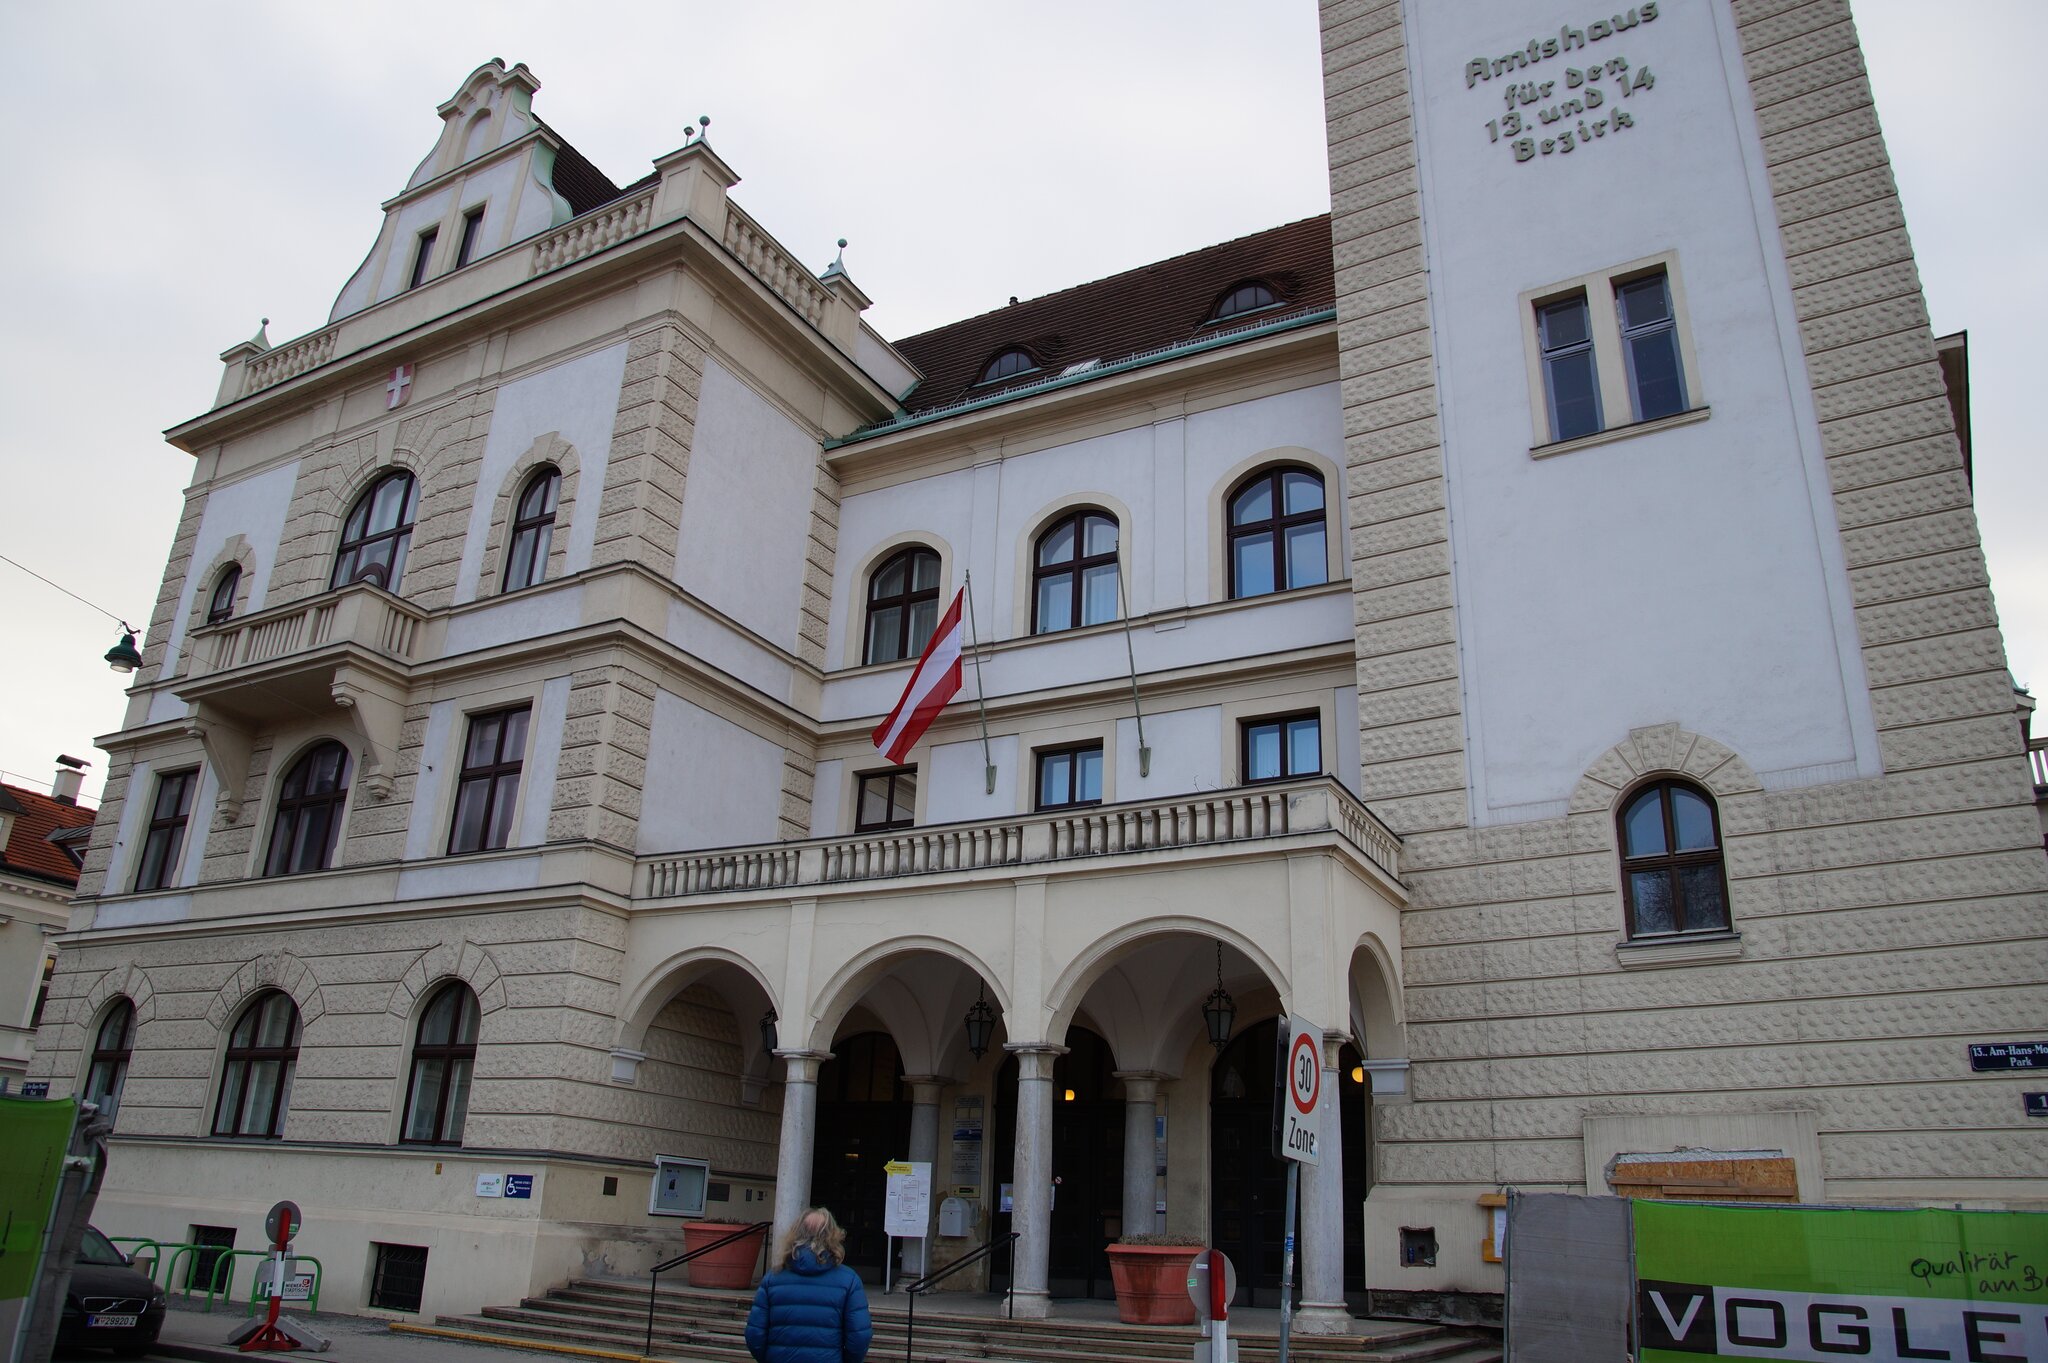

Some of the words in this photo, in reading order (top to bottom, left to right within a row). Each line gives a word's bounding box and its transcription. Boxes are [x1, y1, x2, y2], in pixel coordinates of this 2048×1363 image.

[1464, 2, 1660, 89] Amtshaus
[1484, 111, 1534, 143] 13.
[1537, 86, 1605, 125] und
[1615, 65, 1656, 98] 14
[1503, 80, 1555, 111] für
[1565, 56, 1629, 89] den
[1510, 106, 1635, 162] Bezirk
[1298, 1054, 1312, 1093] 30
[2009, 1056, 2033, 1067] Park
[1288, 1116, 1316, 1155] Zone
[1979, 1279, 2020, 1294] am
[1648, 1289, 2048, 1363] VOGLE
